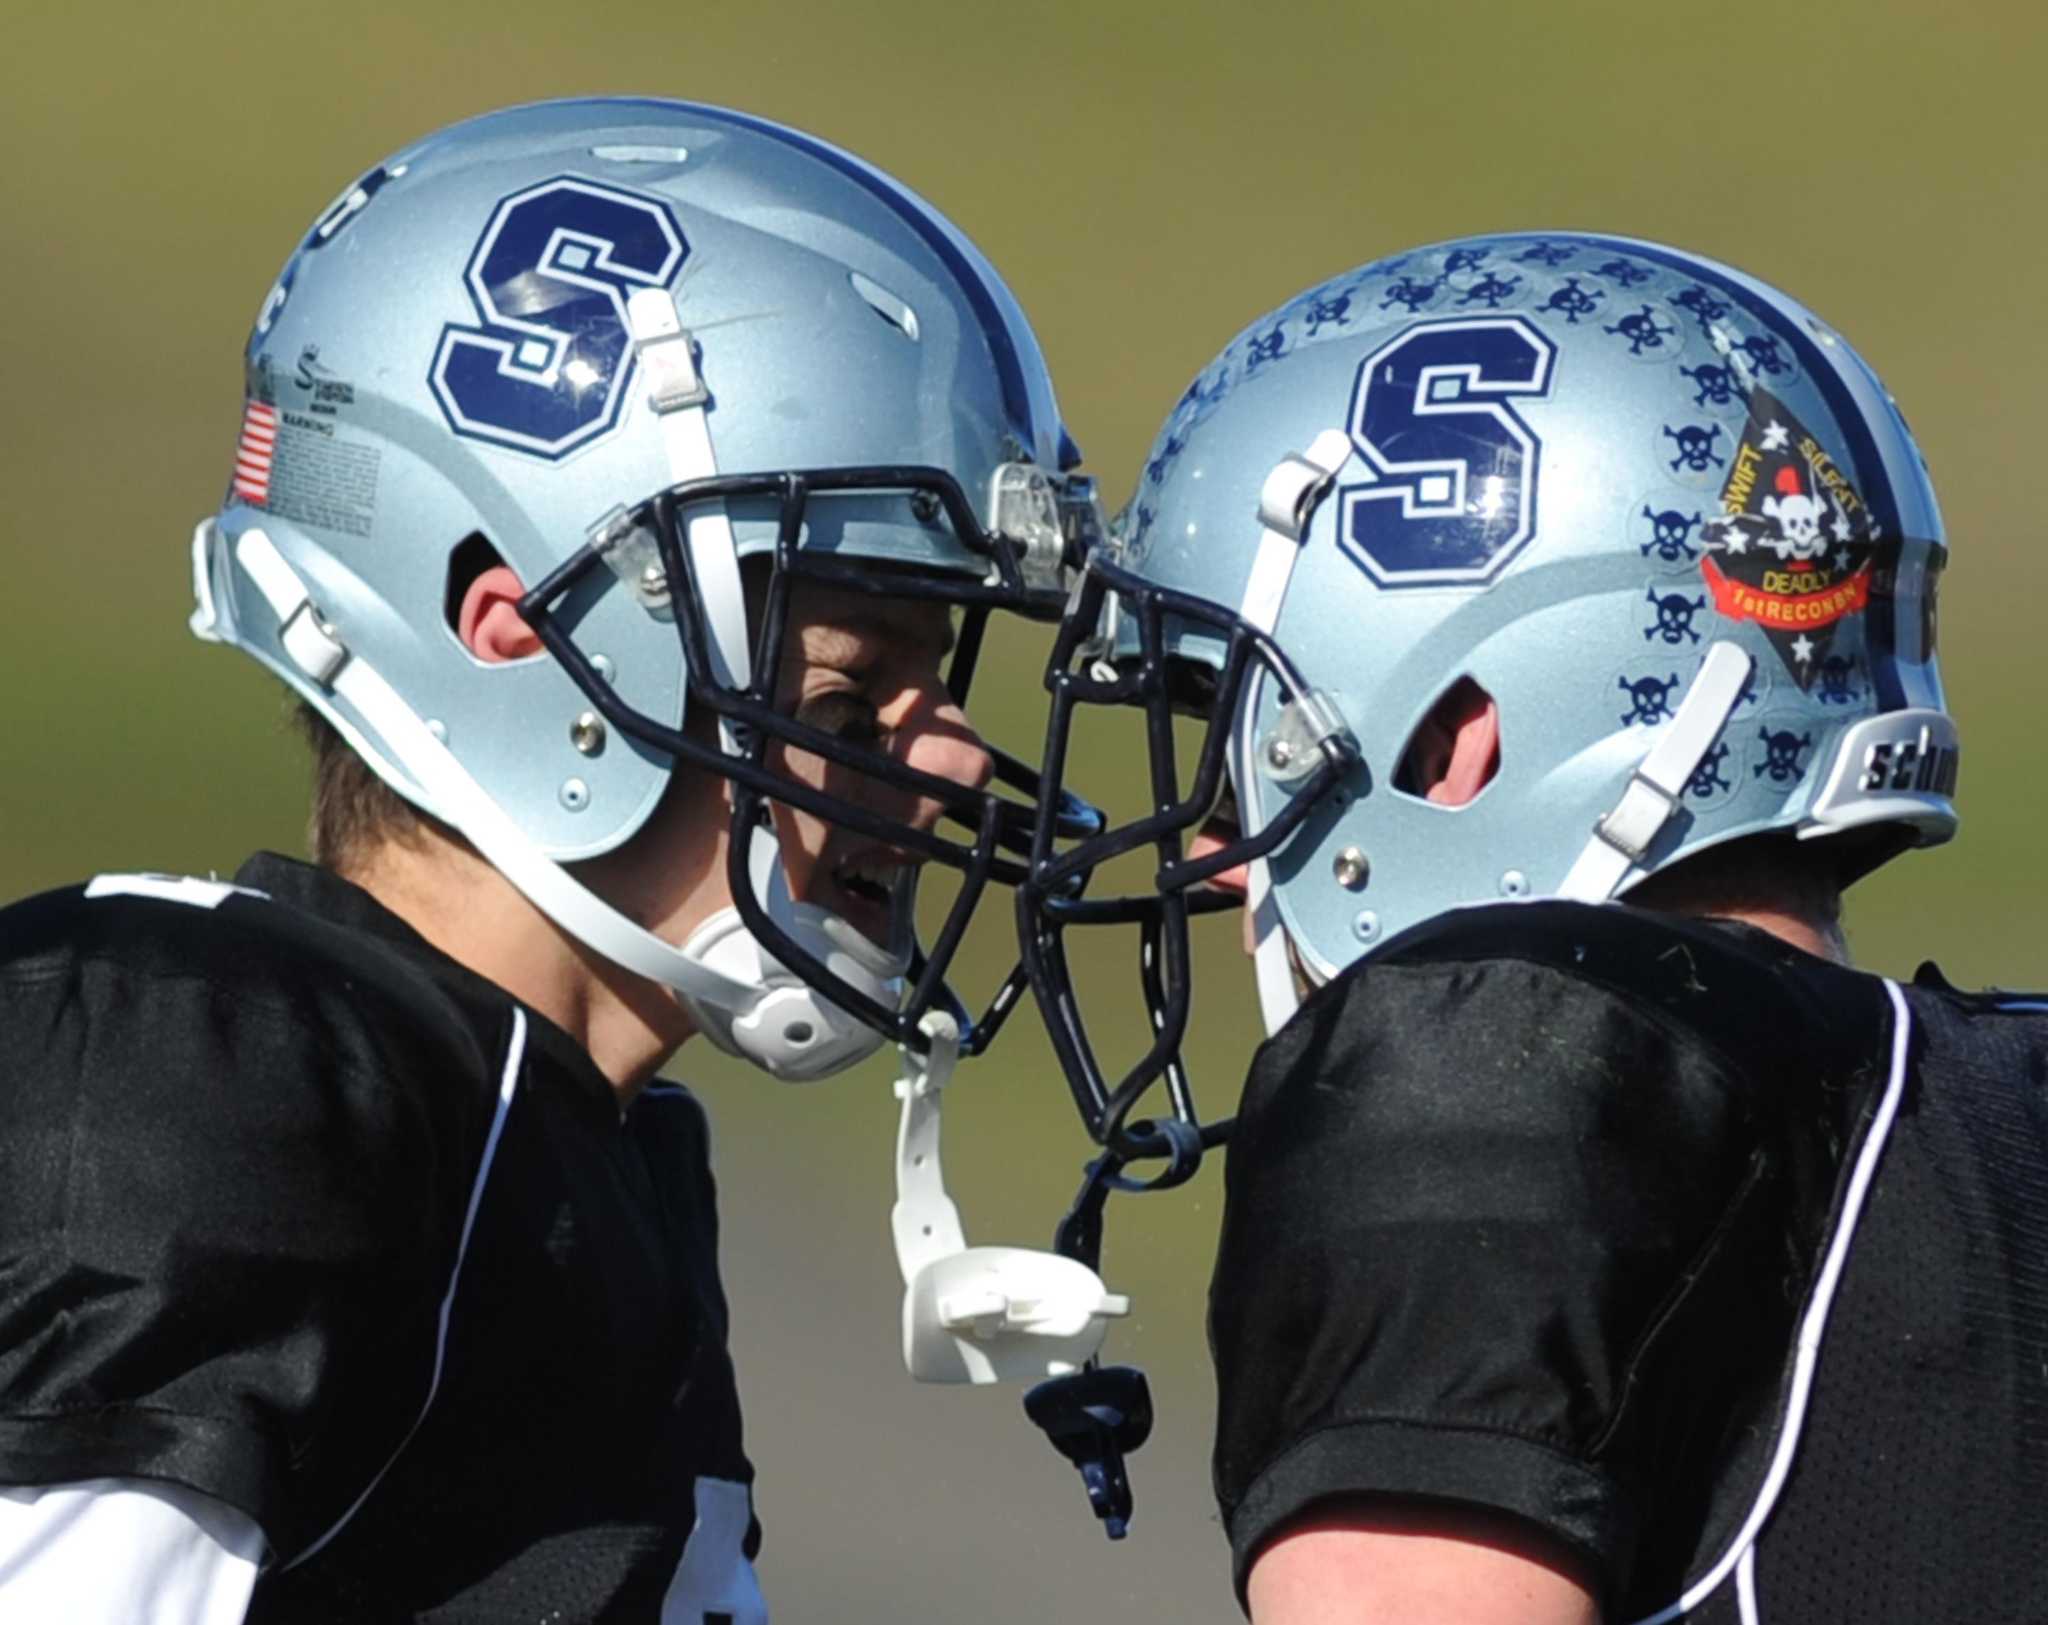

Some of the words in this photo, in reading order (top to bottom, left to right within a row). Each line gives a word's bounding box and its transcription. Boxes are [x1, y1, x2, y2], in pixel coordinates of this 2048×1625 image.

[427, 175, 691, 461] S
[1336, 315, 1558, 591] S
[1725, 442, 1763, 514] SWIFT
[1762, 568, 1832, 595] DEADLY
